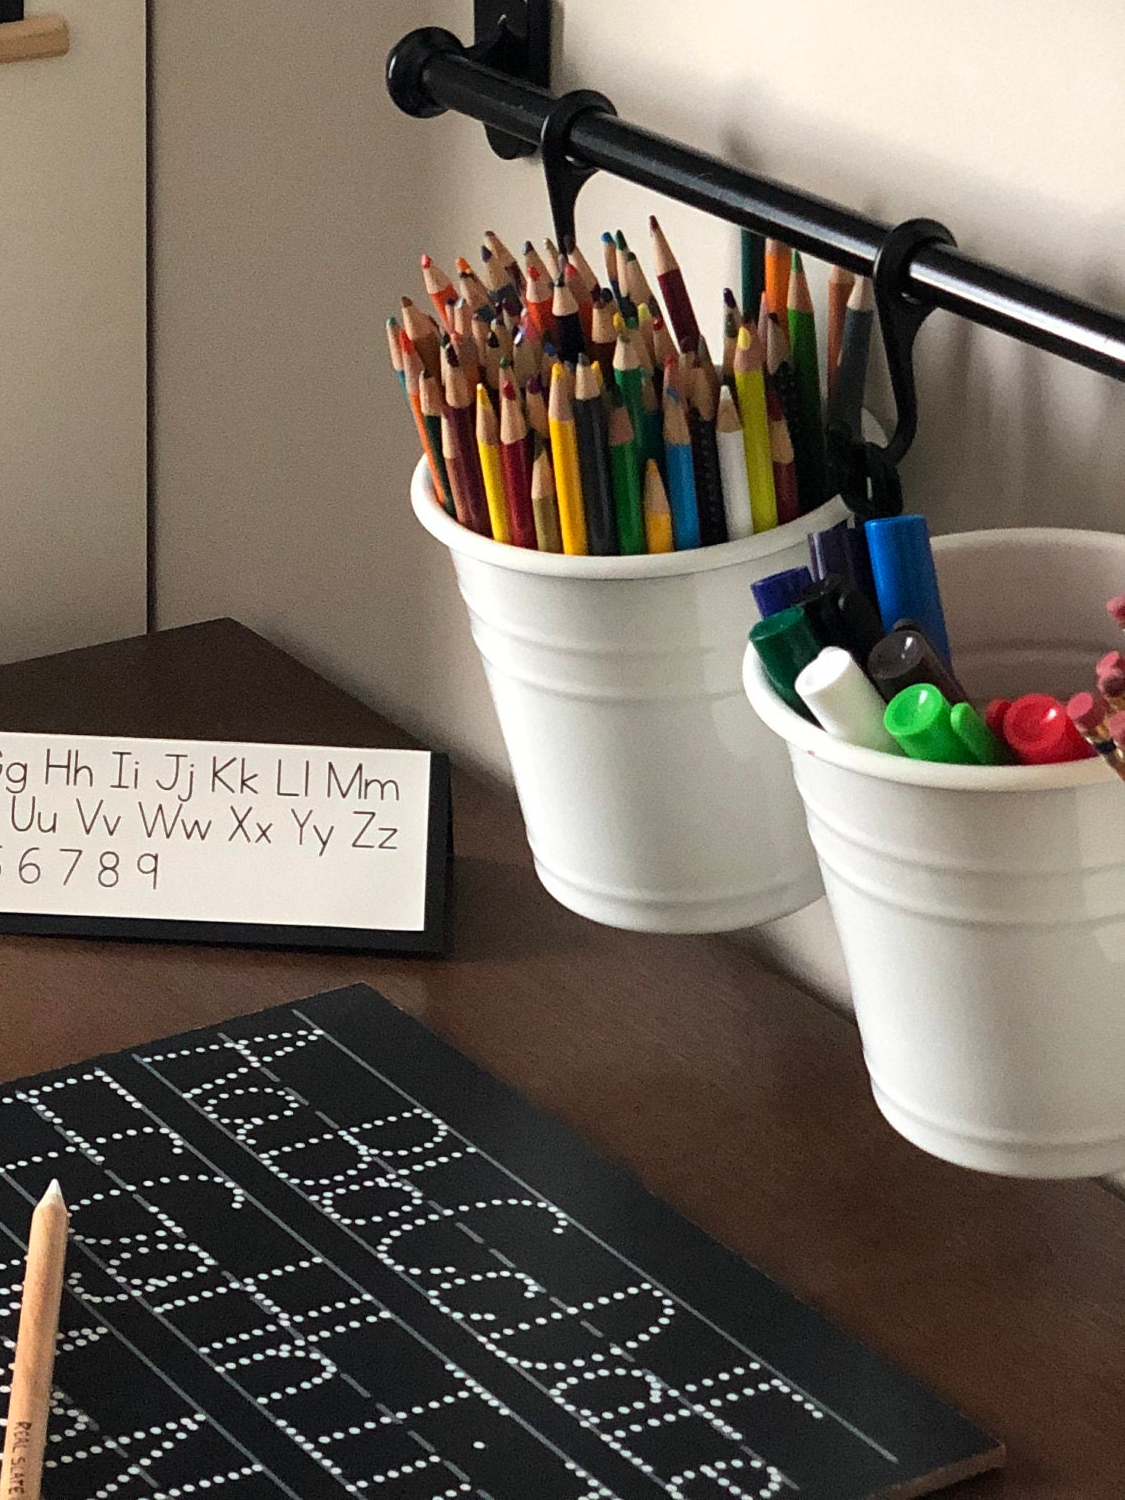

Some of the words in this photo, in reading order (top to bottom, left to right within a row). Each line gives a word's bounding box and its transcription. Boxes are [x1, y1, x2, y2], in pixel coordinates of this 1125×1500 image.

[45, 748, 93, 787] Hh
[110, 751, 139, 789] Ii
[156, 754, 194, 802] Jj
[211, 756, 258, 794] Kk
[277, 759, 309, 797] Ll
[327, 761, 399, 801] Mm
[11, 795, 57, 833] Uu
[76, 798, 121, 836] Vv
[138, 801, 212, 841] Ww
[228, 805, 273, 844] Xx
[291, 808, 334, 857] Yy
[352, 811, 398, 849] Zz
[12, 1421, 32, 1453] REAL
[8, 1457, 26, 1496] SLATE
